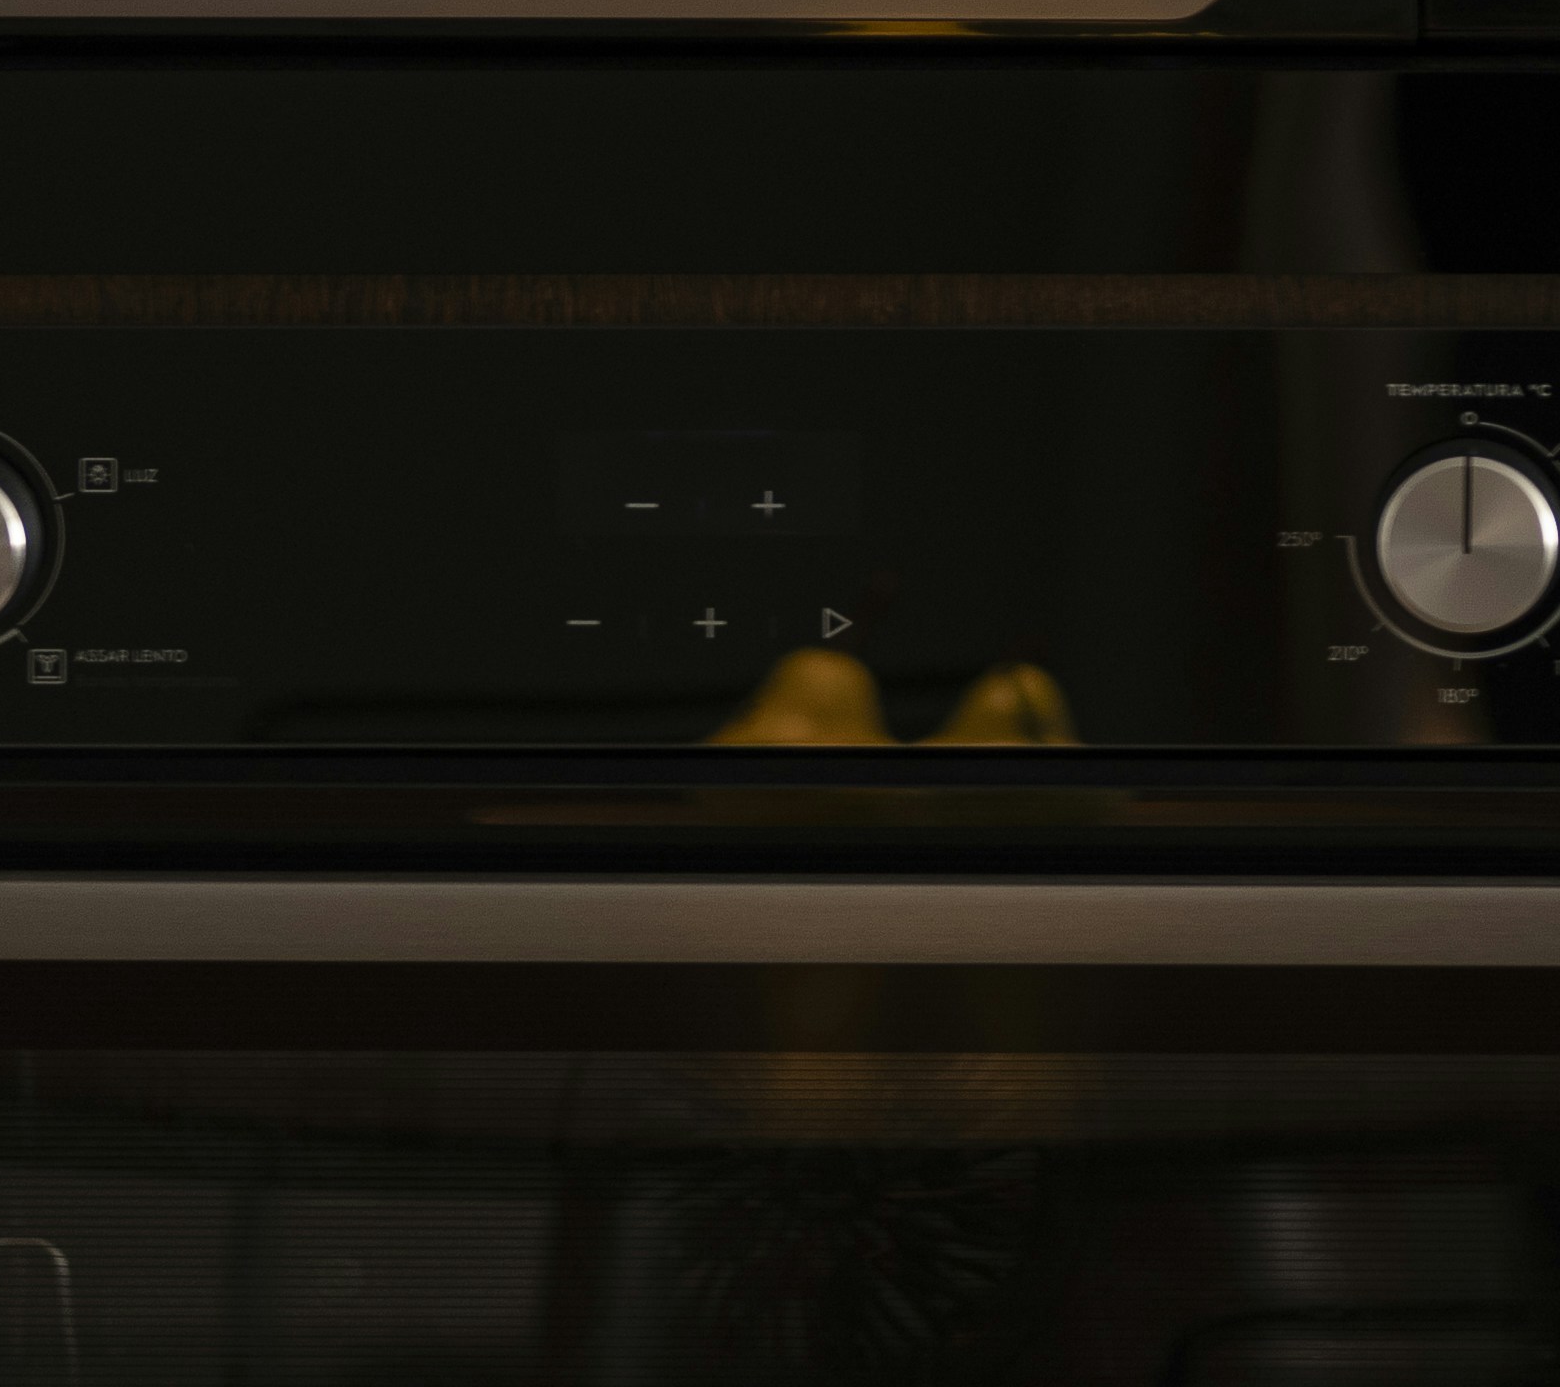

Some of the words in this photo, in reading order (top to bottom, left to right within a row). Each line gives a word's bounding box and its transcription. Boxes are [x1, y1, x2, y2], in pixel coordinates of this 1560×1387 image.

[1384, 382, 1524, 398] TEMPERATURA
[124, 467, 159, 484] LUZ
[74, 648, 130, 663] ASSAR
[131, 648, 188, 664] LENTO
